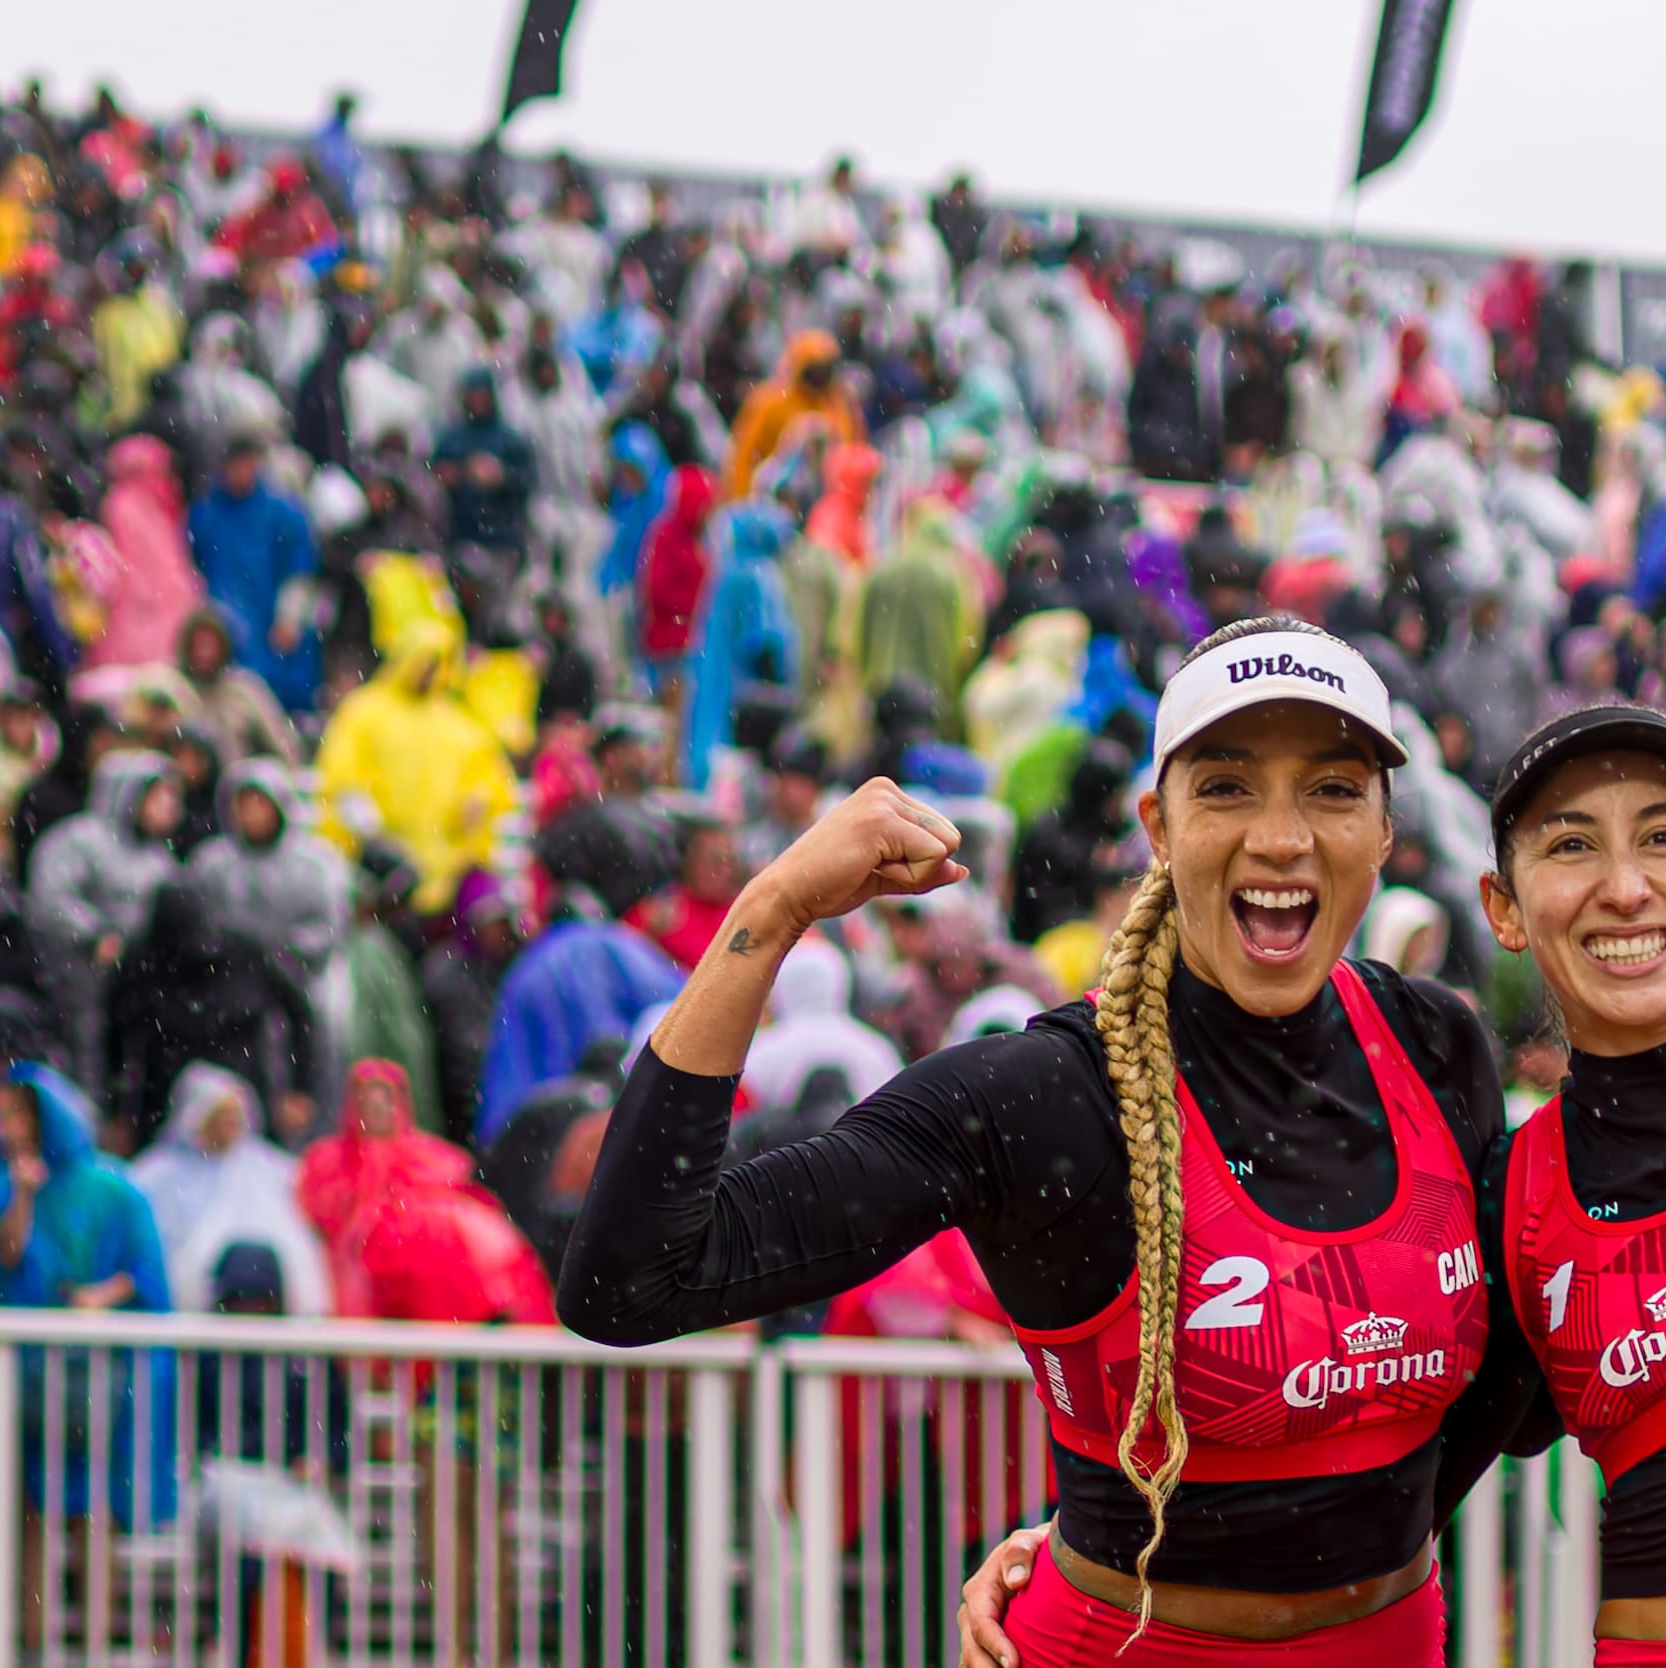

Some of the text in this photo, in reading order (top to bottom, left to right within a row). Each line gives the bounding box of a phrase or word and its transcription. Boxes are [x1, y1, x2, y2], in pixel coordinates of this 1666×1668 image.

[1226, 653, 1346, 694] Wilson
[1587, 1201, 1619, 1220] ON
[1184, 1256, 1270, 1330] 2
[1437, 1240, 1479, 1295] CAN
[1542, 1260, 1575, 1333] 1
[1282, 1346, 1446, 1410] Corona
